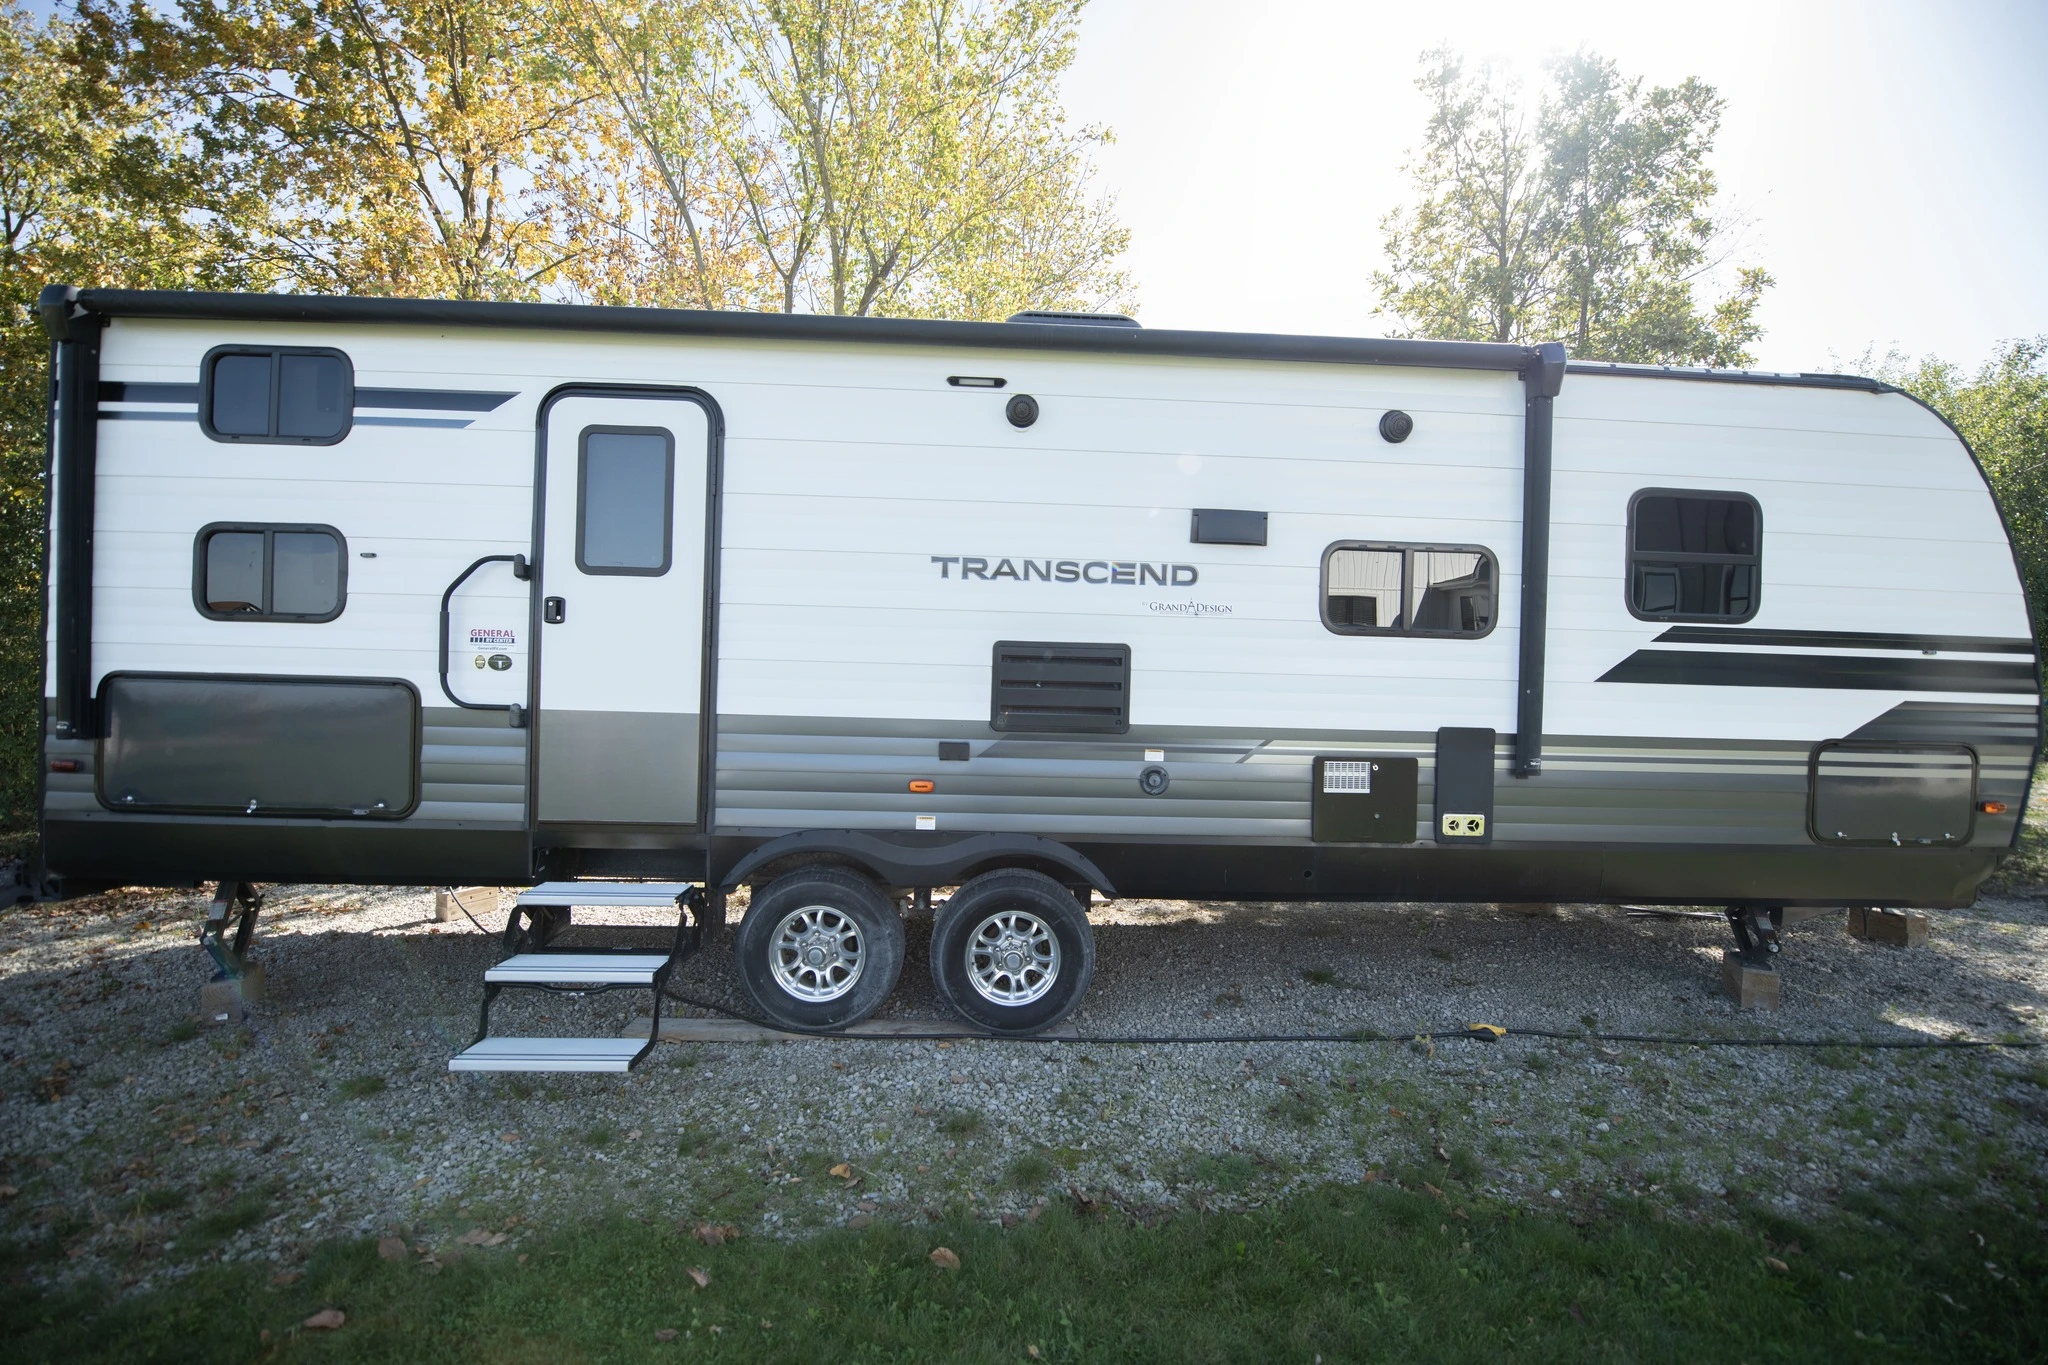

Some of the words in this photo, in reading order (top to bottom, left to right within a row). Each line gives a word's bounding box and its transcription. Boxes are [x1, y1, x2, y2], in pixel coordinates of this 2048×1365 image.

[931, 556, 1200, 587] TRANSCEND
[1149, 601, 1187, 612] GRAND
[1196, 603, 1233, 613] DESIGN
[470, 629, 515, 637] GENERAL
